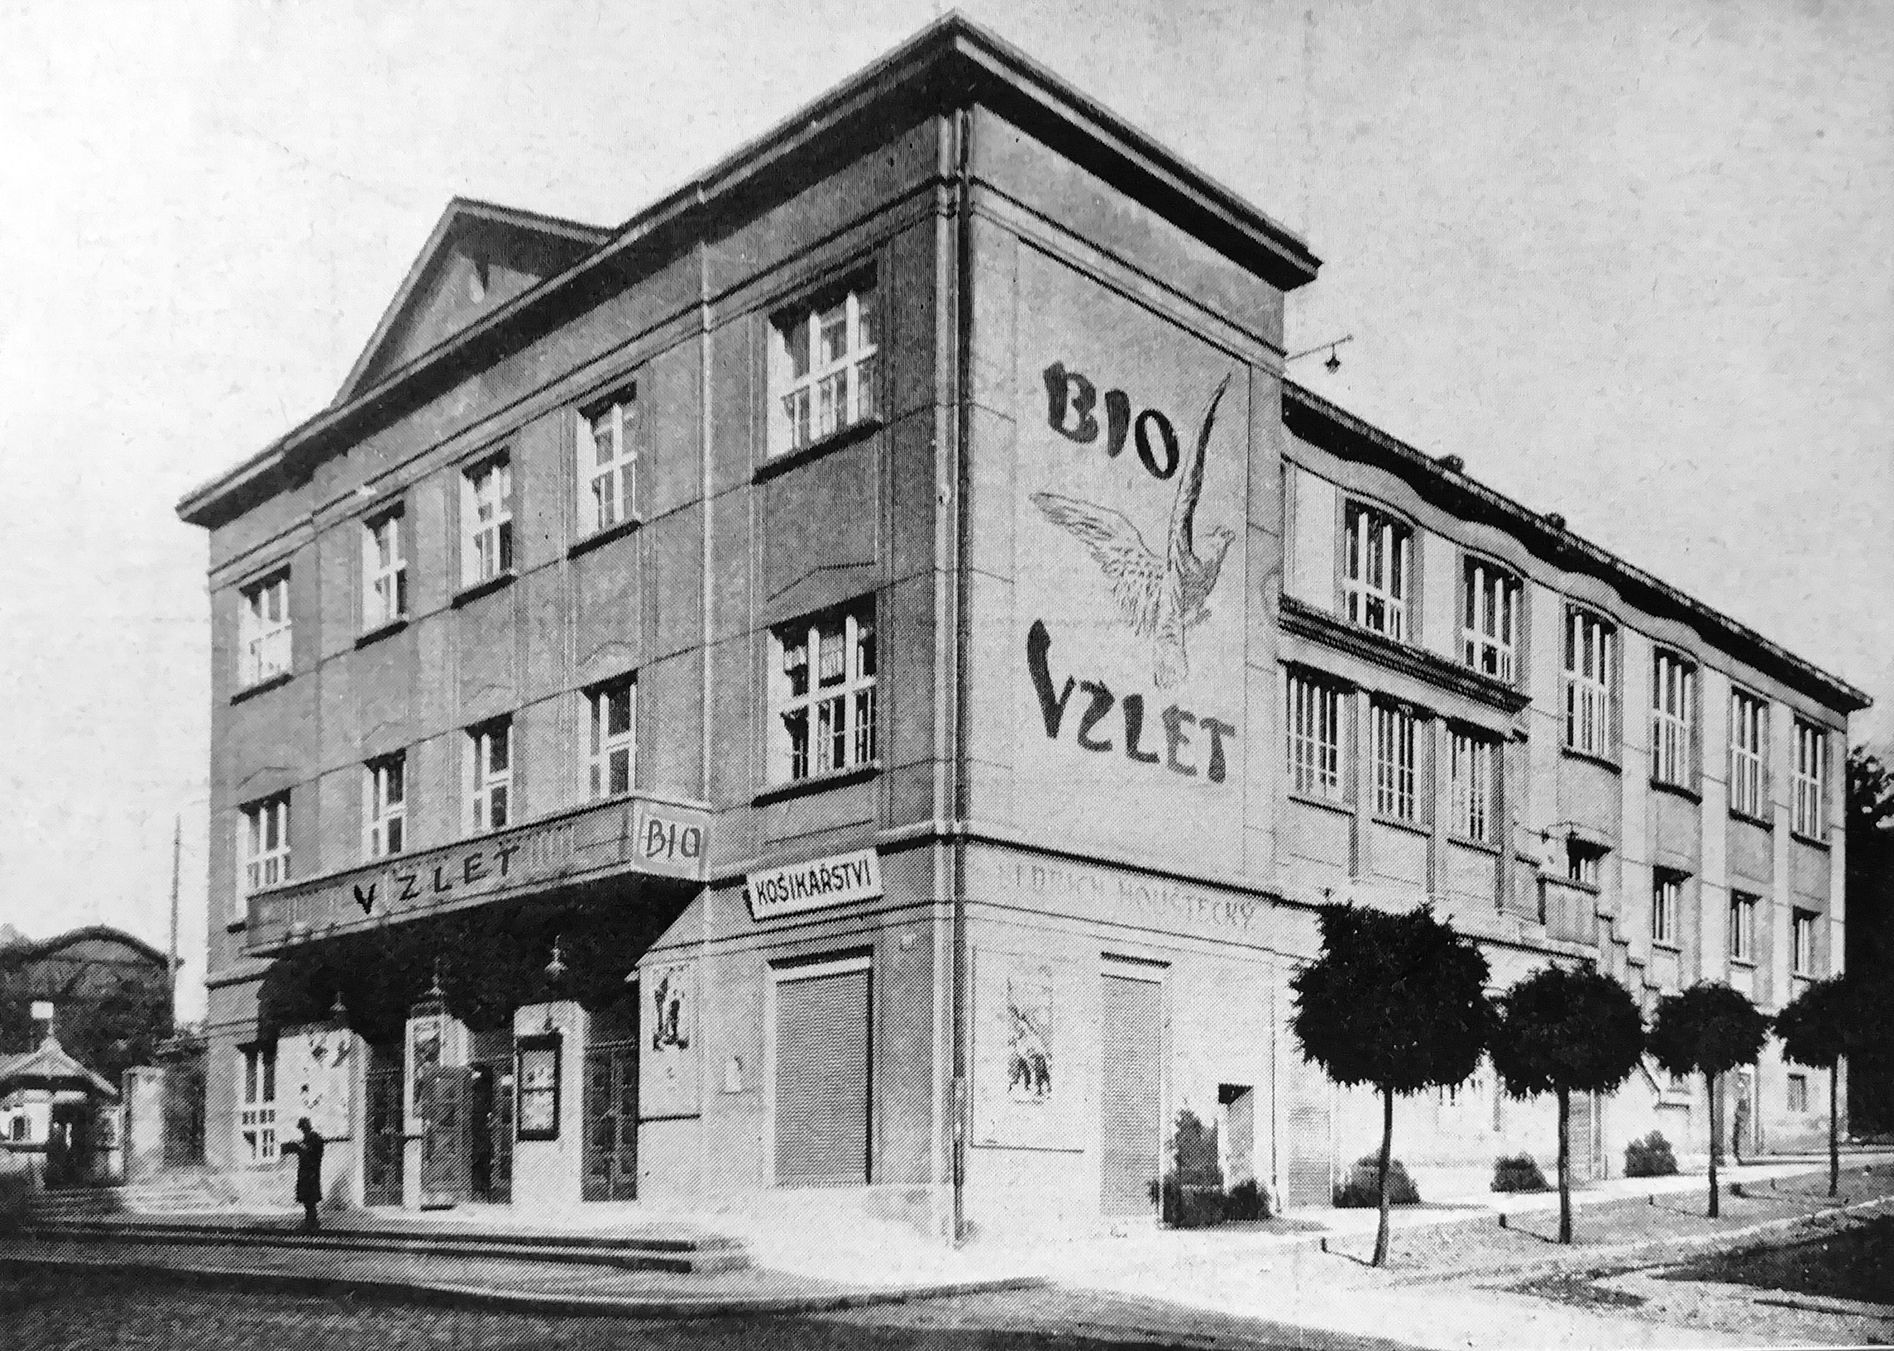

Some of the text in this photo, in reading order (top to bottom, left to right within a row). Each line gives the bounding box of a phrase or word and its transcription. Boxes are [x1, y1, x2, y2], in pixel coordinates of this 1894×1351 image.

[1042, 360, 1180, 480] BIO
[1026, 618, 1236, 784] VZLET
[353, 845, 520, 915] VZLET
[646, 819, 701, 858] BIO
